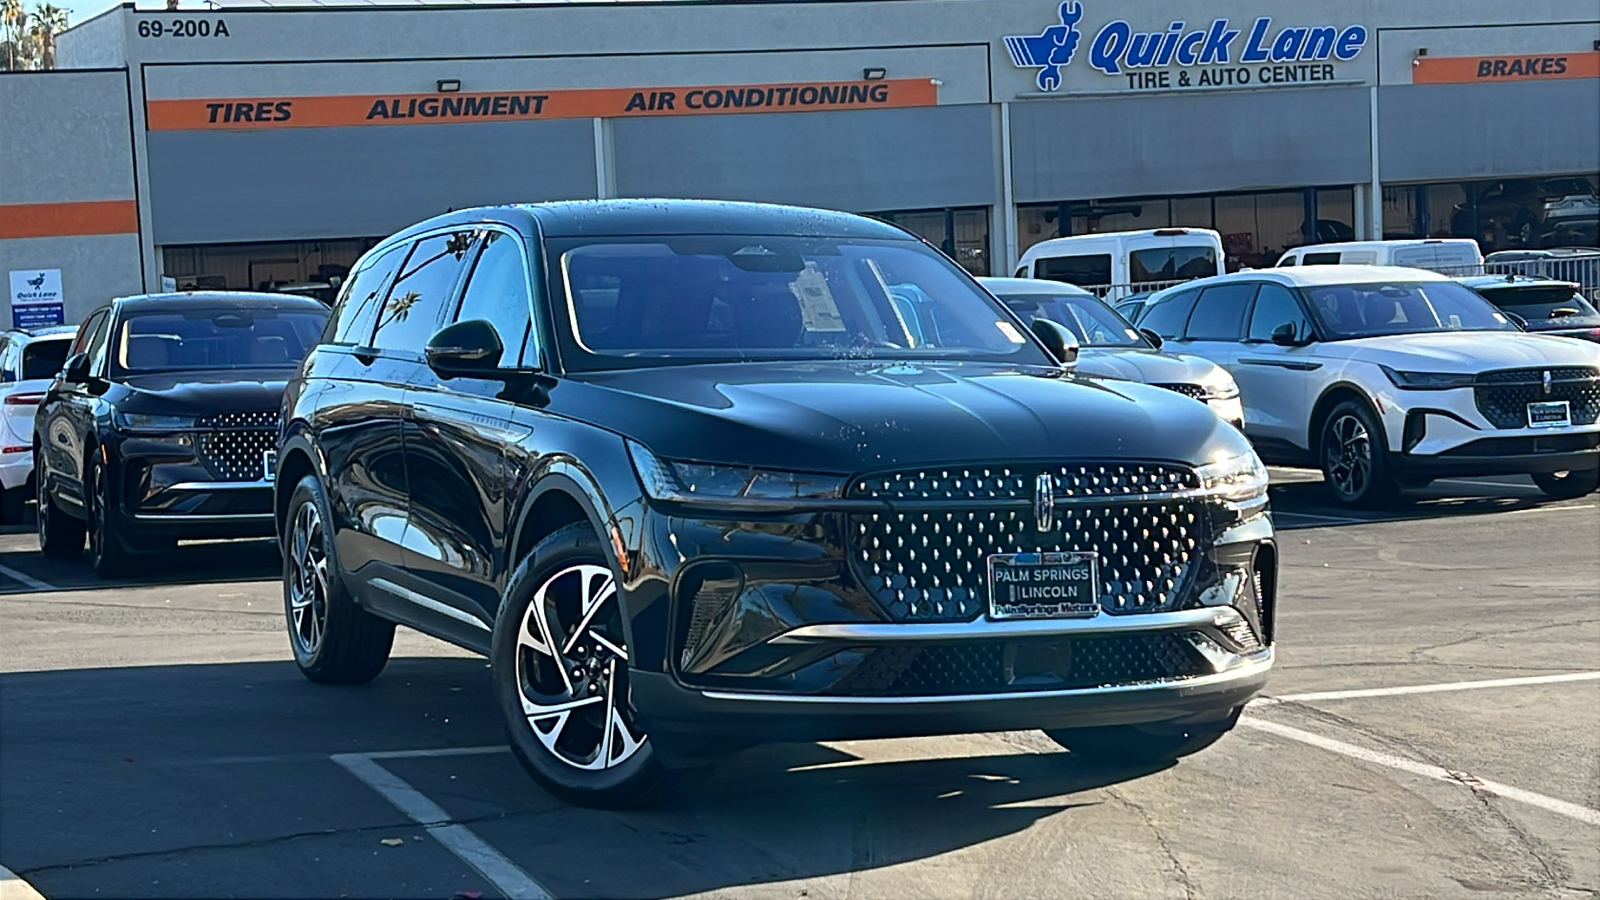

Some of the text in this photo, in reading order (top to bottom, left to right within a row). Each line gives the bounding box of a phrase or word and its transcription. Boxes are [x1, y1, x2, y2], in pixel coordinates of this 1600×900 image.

[138, 20, 229, 37] 69-200 A
[1089, 16, 1368, 75] Quick Lane
[1126, 64, 1335, 89] TIRE & AUTO CENTER
[1477, 58, 1568, 77] BRAKES
[366, 95, 549, 120] ALIGNMENT
[625, 84, 889, 112] AIR CONDITIONING
[206, 102, 292, 123] TIRES
[995, 568, 1089, 582] PALM SPRINGS
[1021, 586, 1078, 599] LINCOLN
